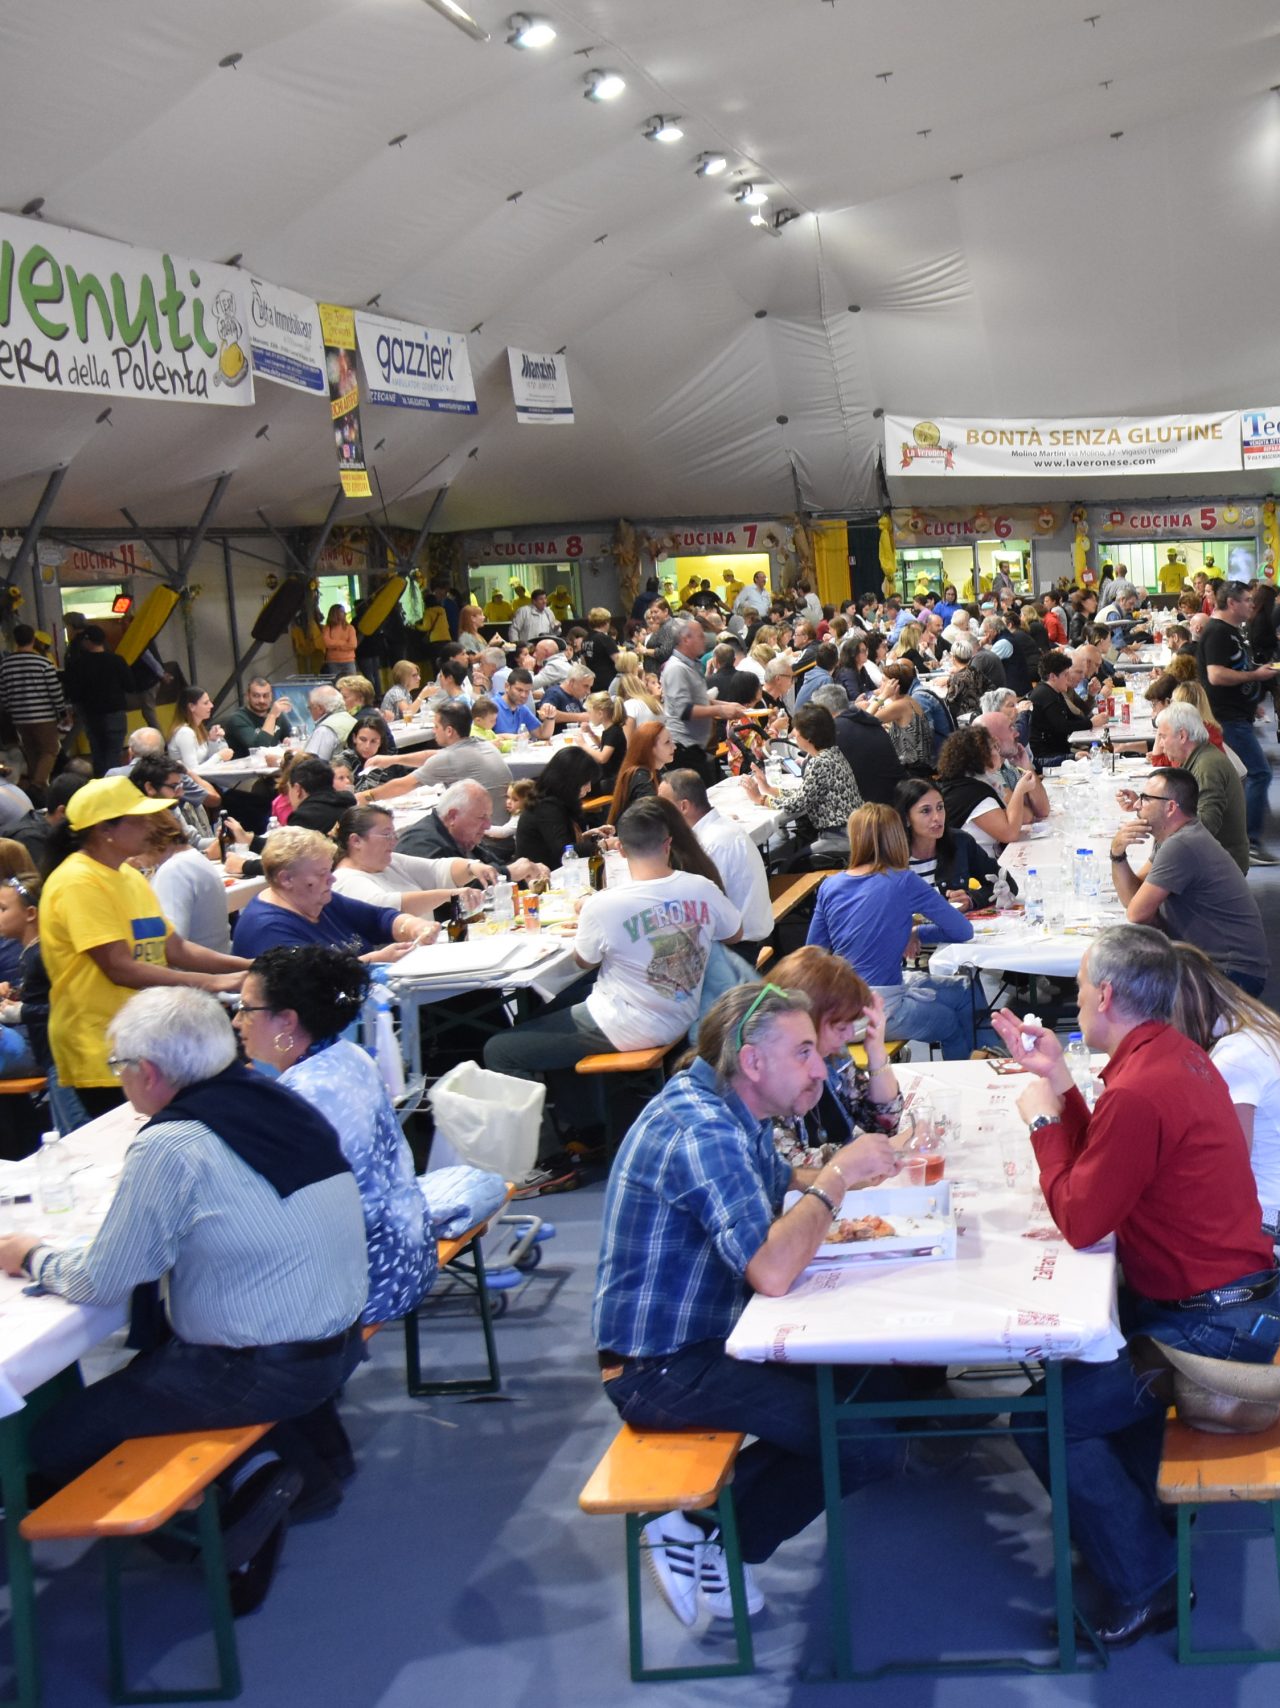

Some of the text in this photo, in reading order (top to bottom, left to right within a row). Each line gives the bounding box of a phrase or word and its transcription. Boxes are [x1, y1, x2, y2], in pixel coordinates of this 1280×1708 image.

[68, 353, 110, 389] della
[112, 340, 209, 399] Polenta
[376, 331, 454, 384] gazzieri
[521, 353, 557, 381] Manzini
[966, 423, 1223, 446] BONTÀ SENZA GLUTINE
[1034, 458, 1156, 468] www.laveronese.com
[1039, 449, 1067, 457] Martini
[1121, 448, 1147, 458] Vigasio
[923, 515, 1012, 538] CUCIN 6
[1129, 507, 1217, 531] CUCINA 5
[493, 535, 584, 557] CUCINA 8
[742, 524, 758, 549] 7
[73, 544, 136, 577] CUCINA 11
[622, 900, 711, 944] VERONA
